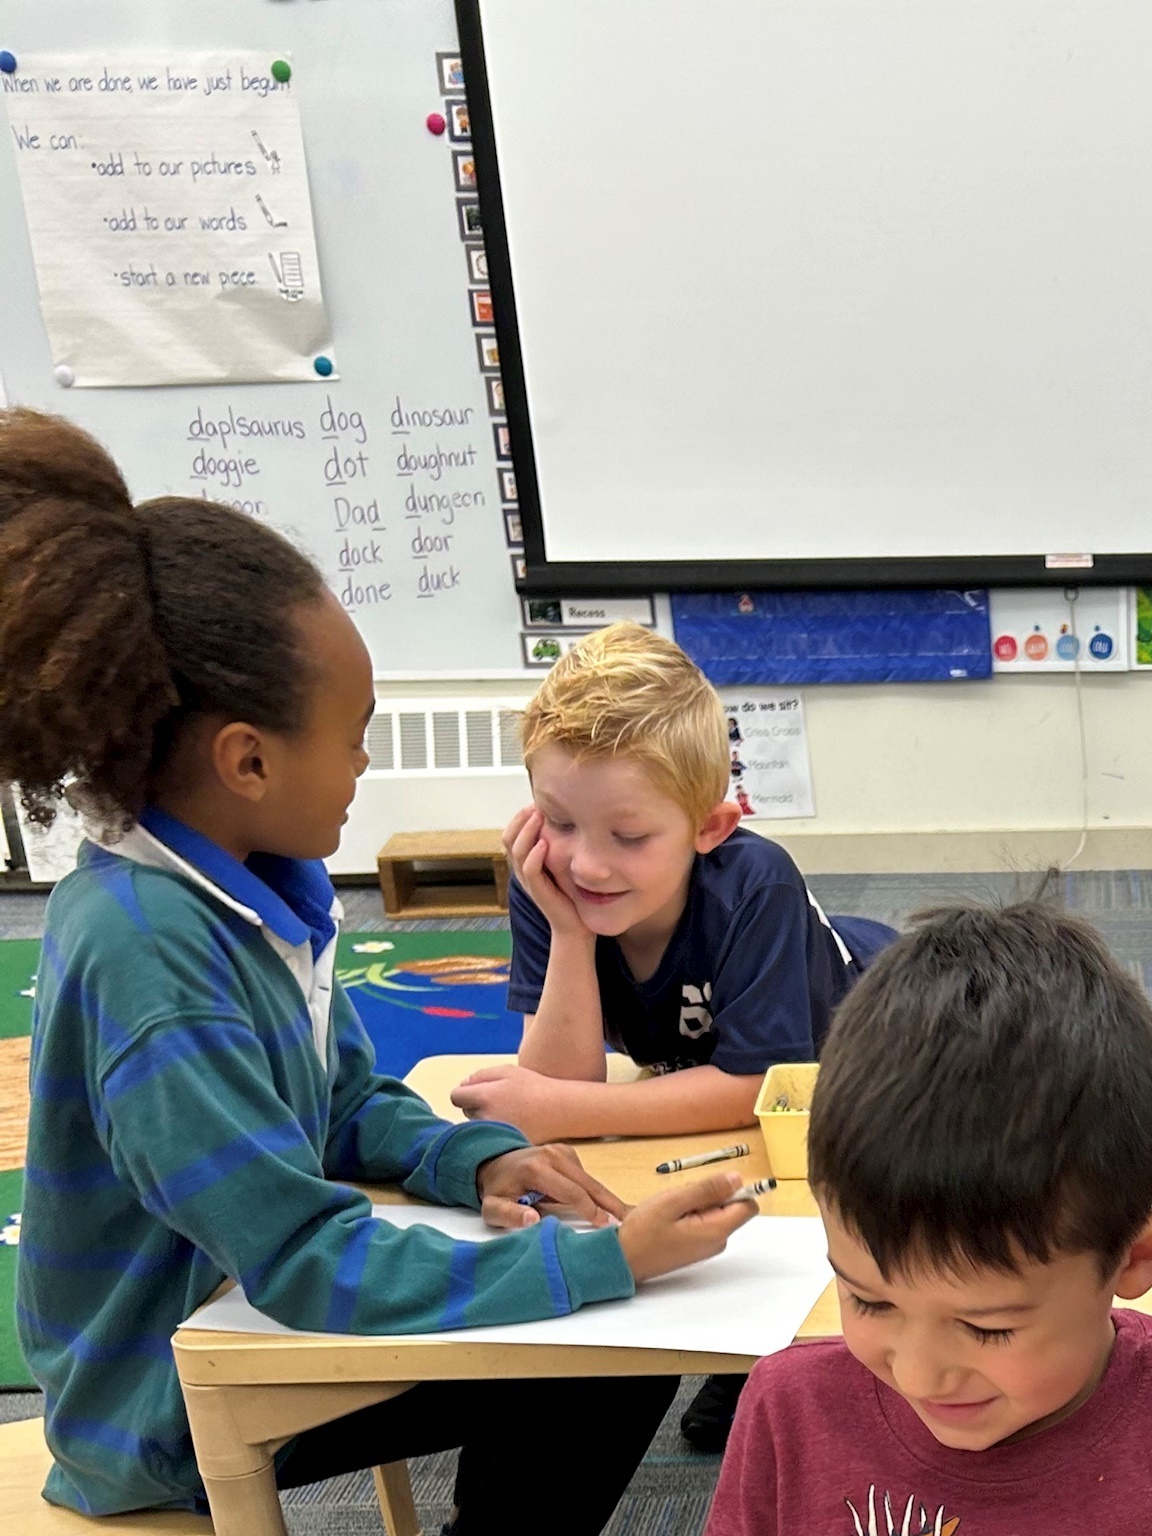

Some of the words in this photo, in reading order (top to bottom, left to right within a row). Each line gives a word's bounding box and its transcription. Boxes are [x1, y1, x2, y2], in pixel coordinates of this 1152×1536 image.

[2, 71, 39, 92] When
[45, 78, 61, 92] we
[69, 77, 93, 92] are
[98, 67, 133, 94] done,
[138, 77, 159, 92] we
[166, 67, 198, 91] have
[204, 67, 232, 96] just
[11, 124, 41, 150] We
[97, 152, 125, 176] add
[134, 152, 152, 176] to
[159, 161, 184, 176] our
[191, 152, 258, 183] pictures
[109, 207, 137, 231] add
[143, 206, 159, 230] to
[164, 216, 188, 230] our
[199, 206, 248, 230] words
[120, 263, 157, 286] start
[165, 271, 176, 286] a
[184, 272, 210, 286] new
[219, 271, 256, 289] piece
[320, 395, 368, 443] dog
[391, 396, 474, 434] dinosaur
[191, 447, 260, 487] doggie
[324, 446, 369, 485] dot
[397, 444, 477, 481] doughnut
[334, 497, 386, 531] Dad
[405, 483, 486, 525] dungeon
[339, 538, 383, 571] dock
[411, 526, 454, 558] door
[341, 577, 392, 612] done
[417, 566, 460, 598] duck
[569, 607, 605, 618] Recess
[742, 702, 756, 712] do
[760, 703, 776, 712] we
[778, 699, 799, 711] sit?
